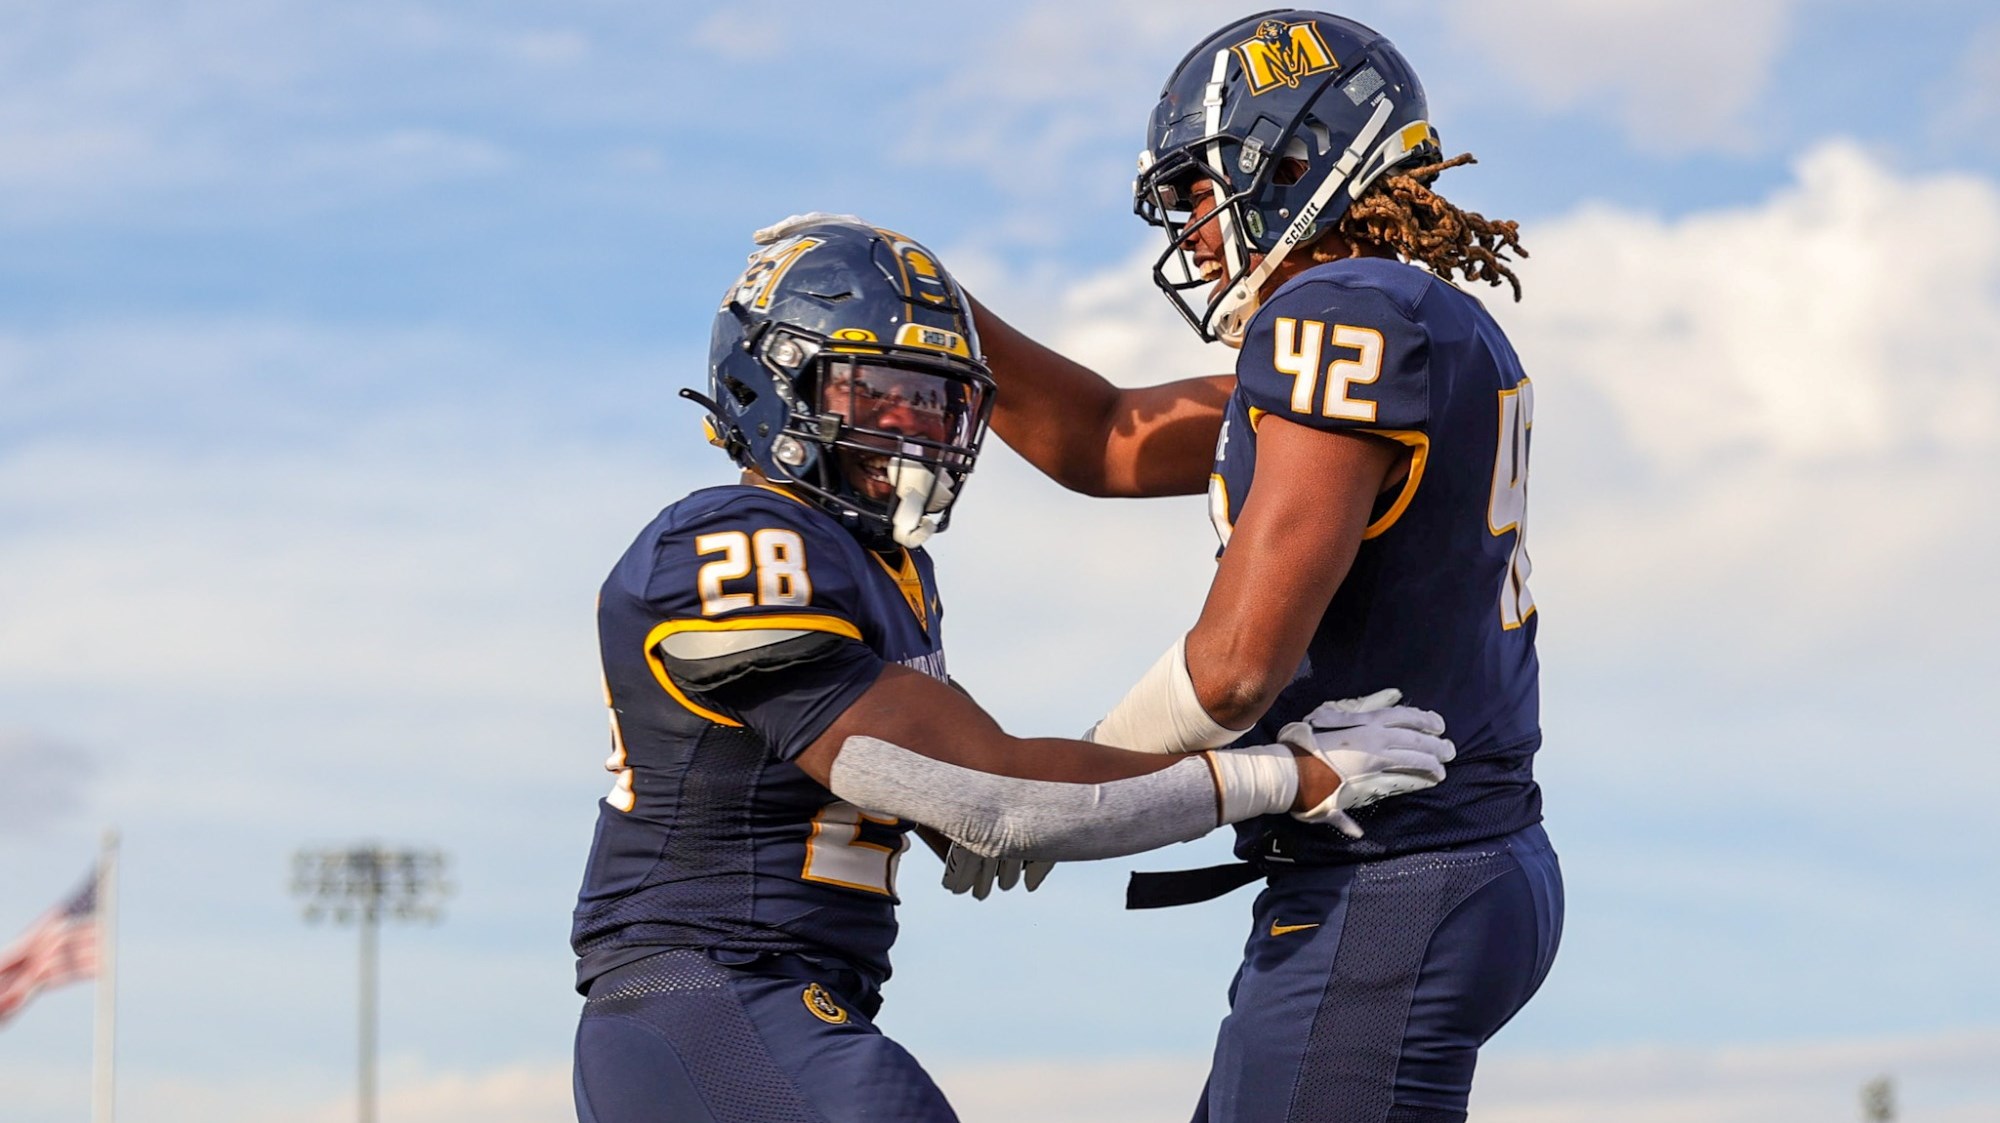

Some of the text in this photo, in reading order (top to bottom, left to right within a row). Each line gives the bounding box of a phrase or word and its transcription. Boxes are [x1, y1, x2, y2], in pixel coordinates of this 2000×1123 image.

[1285, 202, 1320, 247] schutt
[1273, 316, 1386, 423] 42
[694, 528, 813, 617] 28
